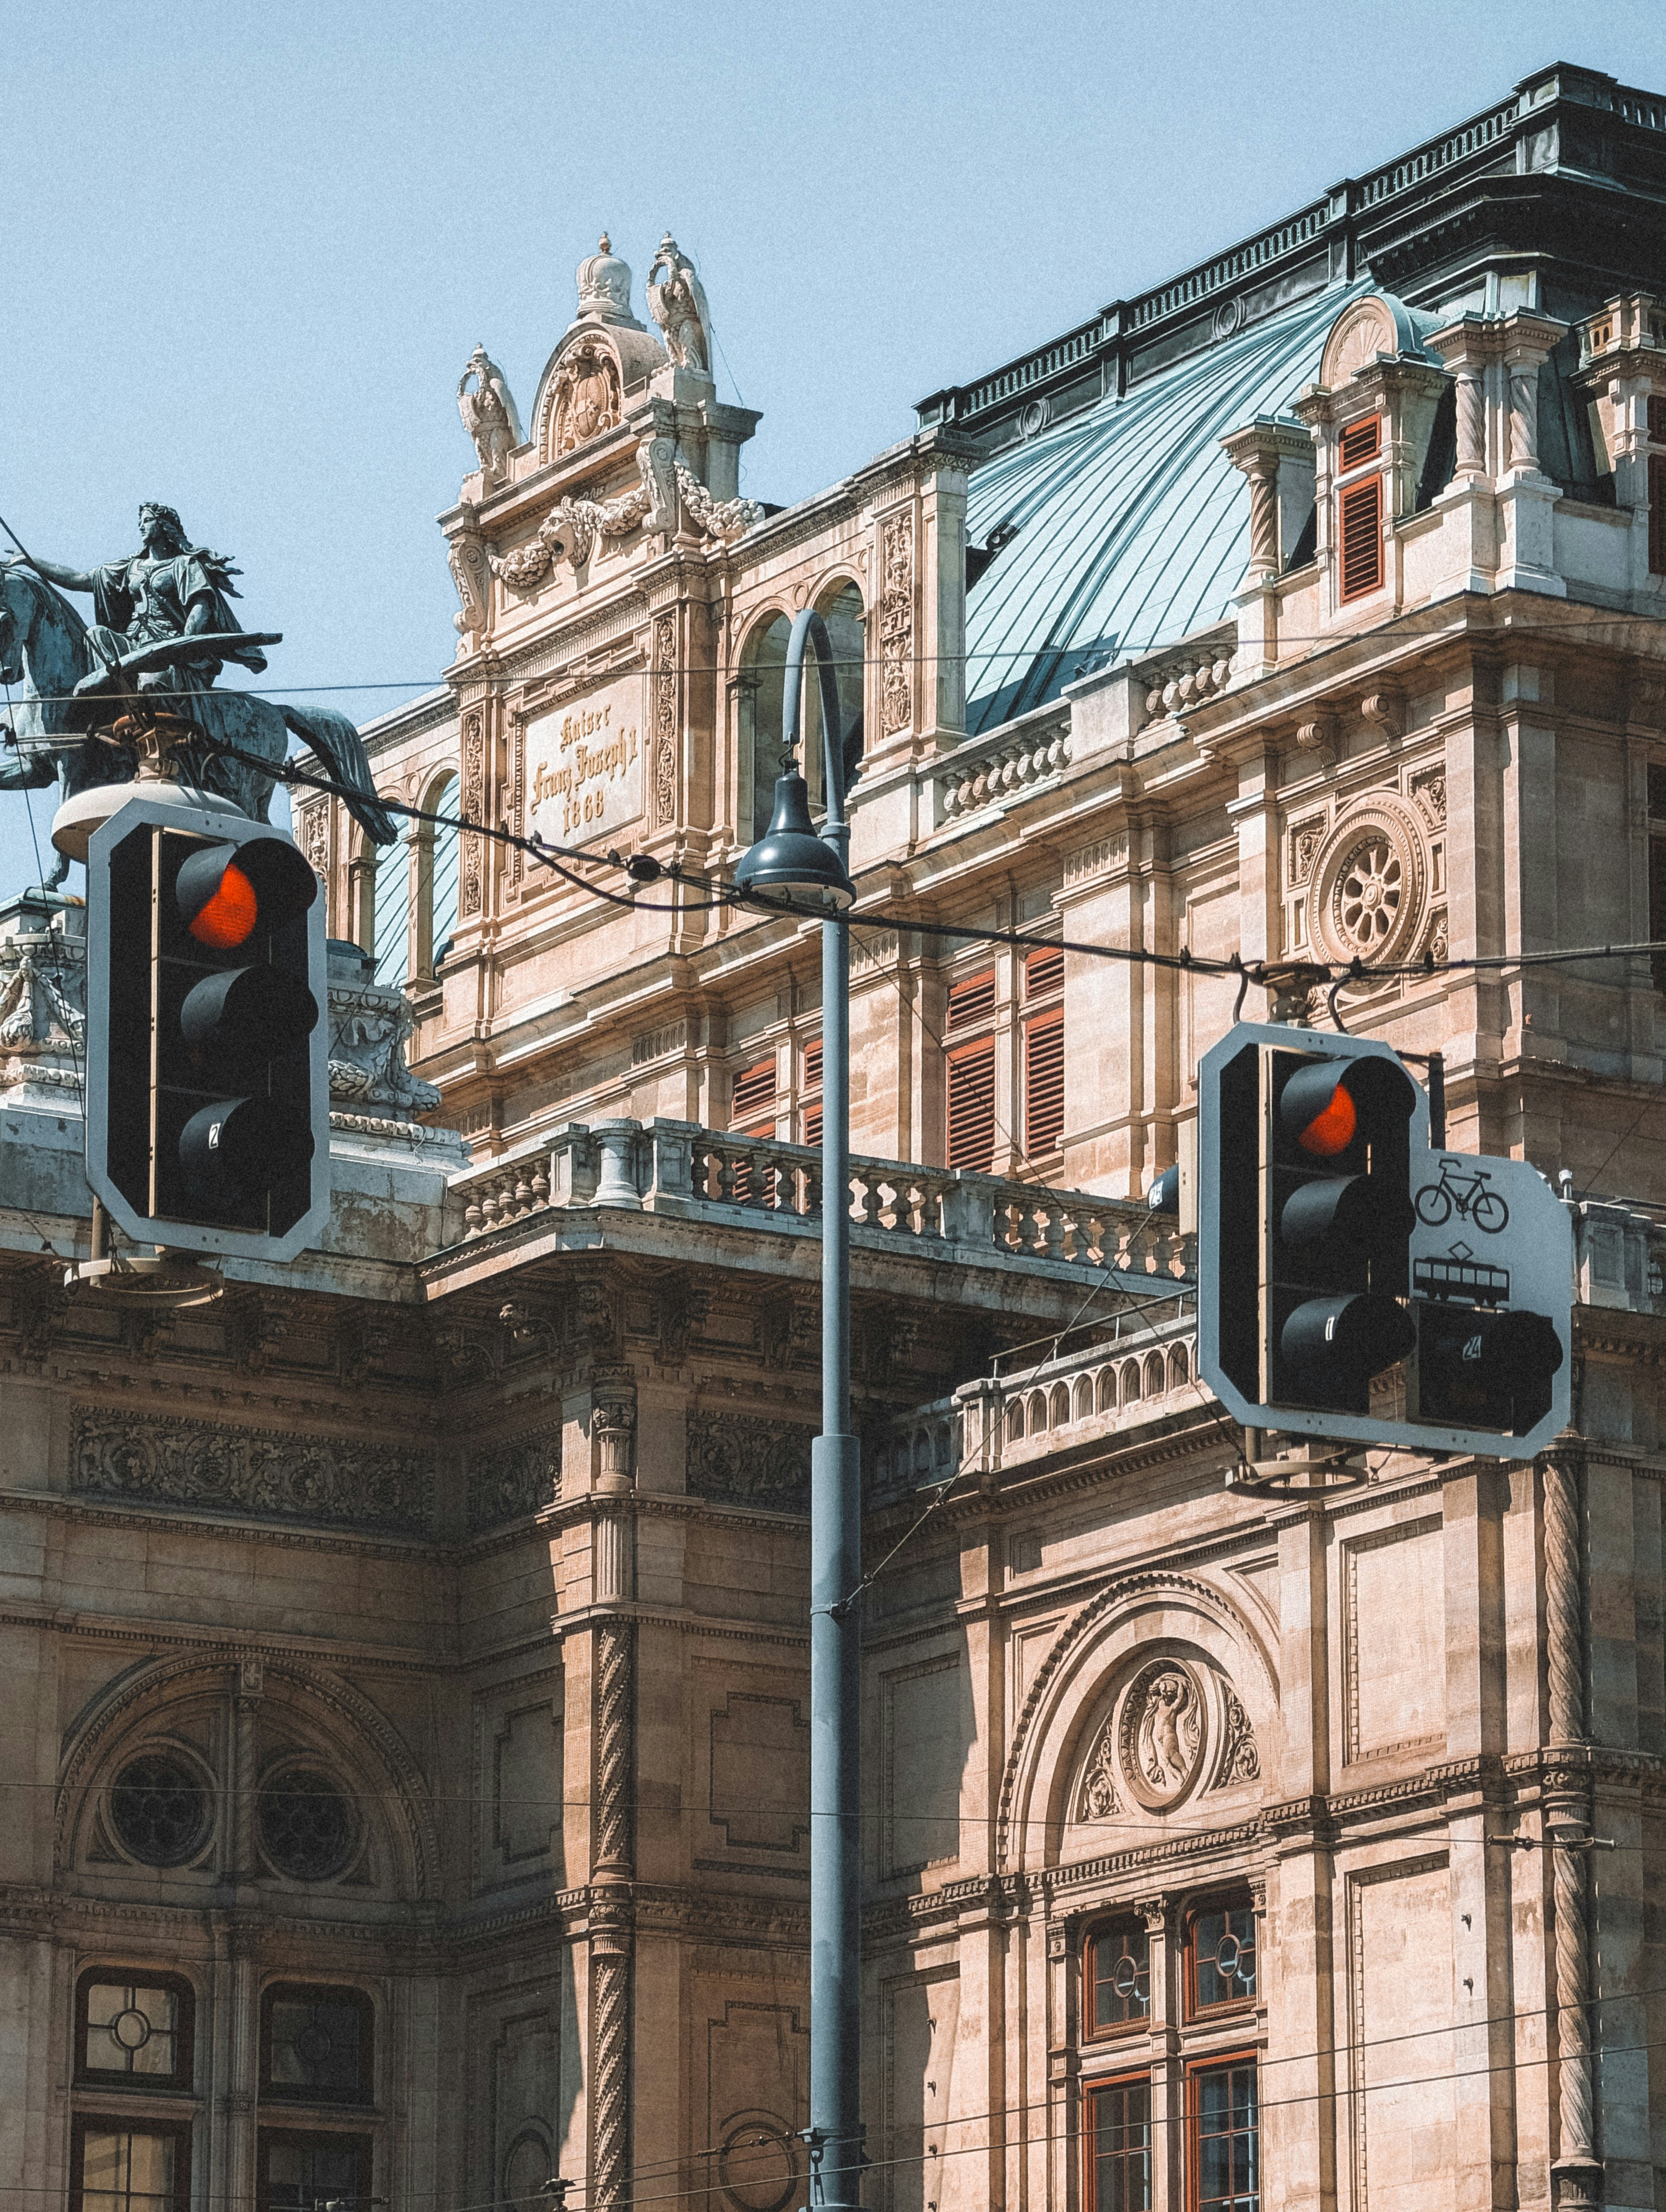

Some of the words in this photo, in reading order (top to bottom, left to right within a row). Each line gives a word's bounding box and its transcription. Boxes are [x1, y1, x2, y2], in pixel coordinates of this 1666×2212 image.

[560, 704, 611, 753] Kaiser
[563, 789, 604, 837] 1868
[211, 1126, 218, 1147] 2
[1464, 1337, 1479, 1358] 24
